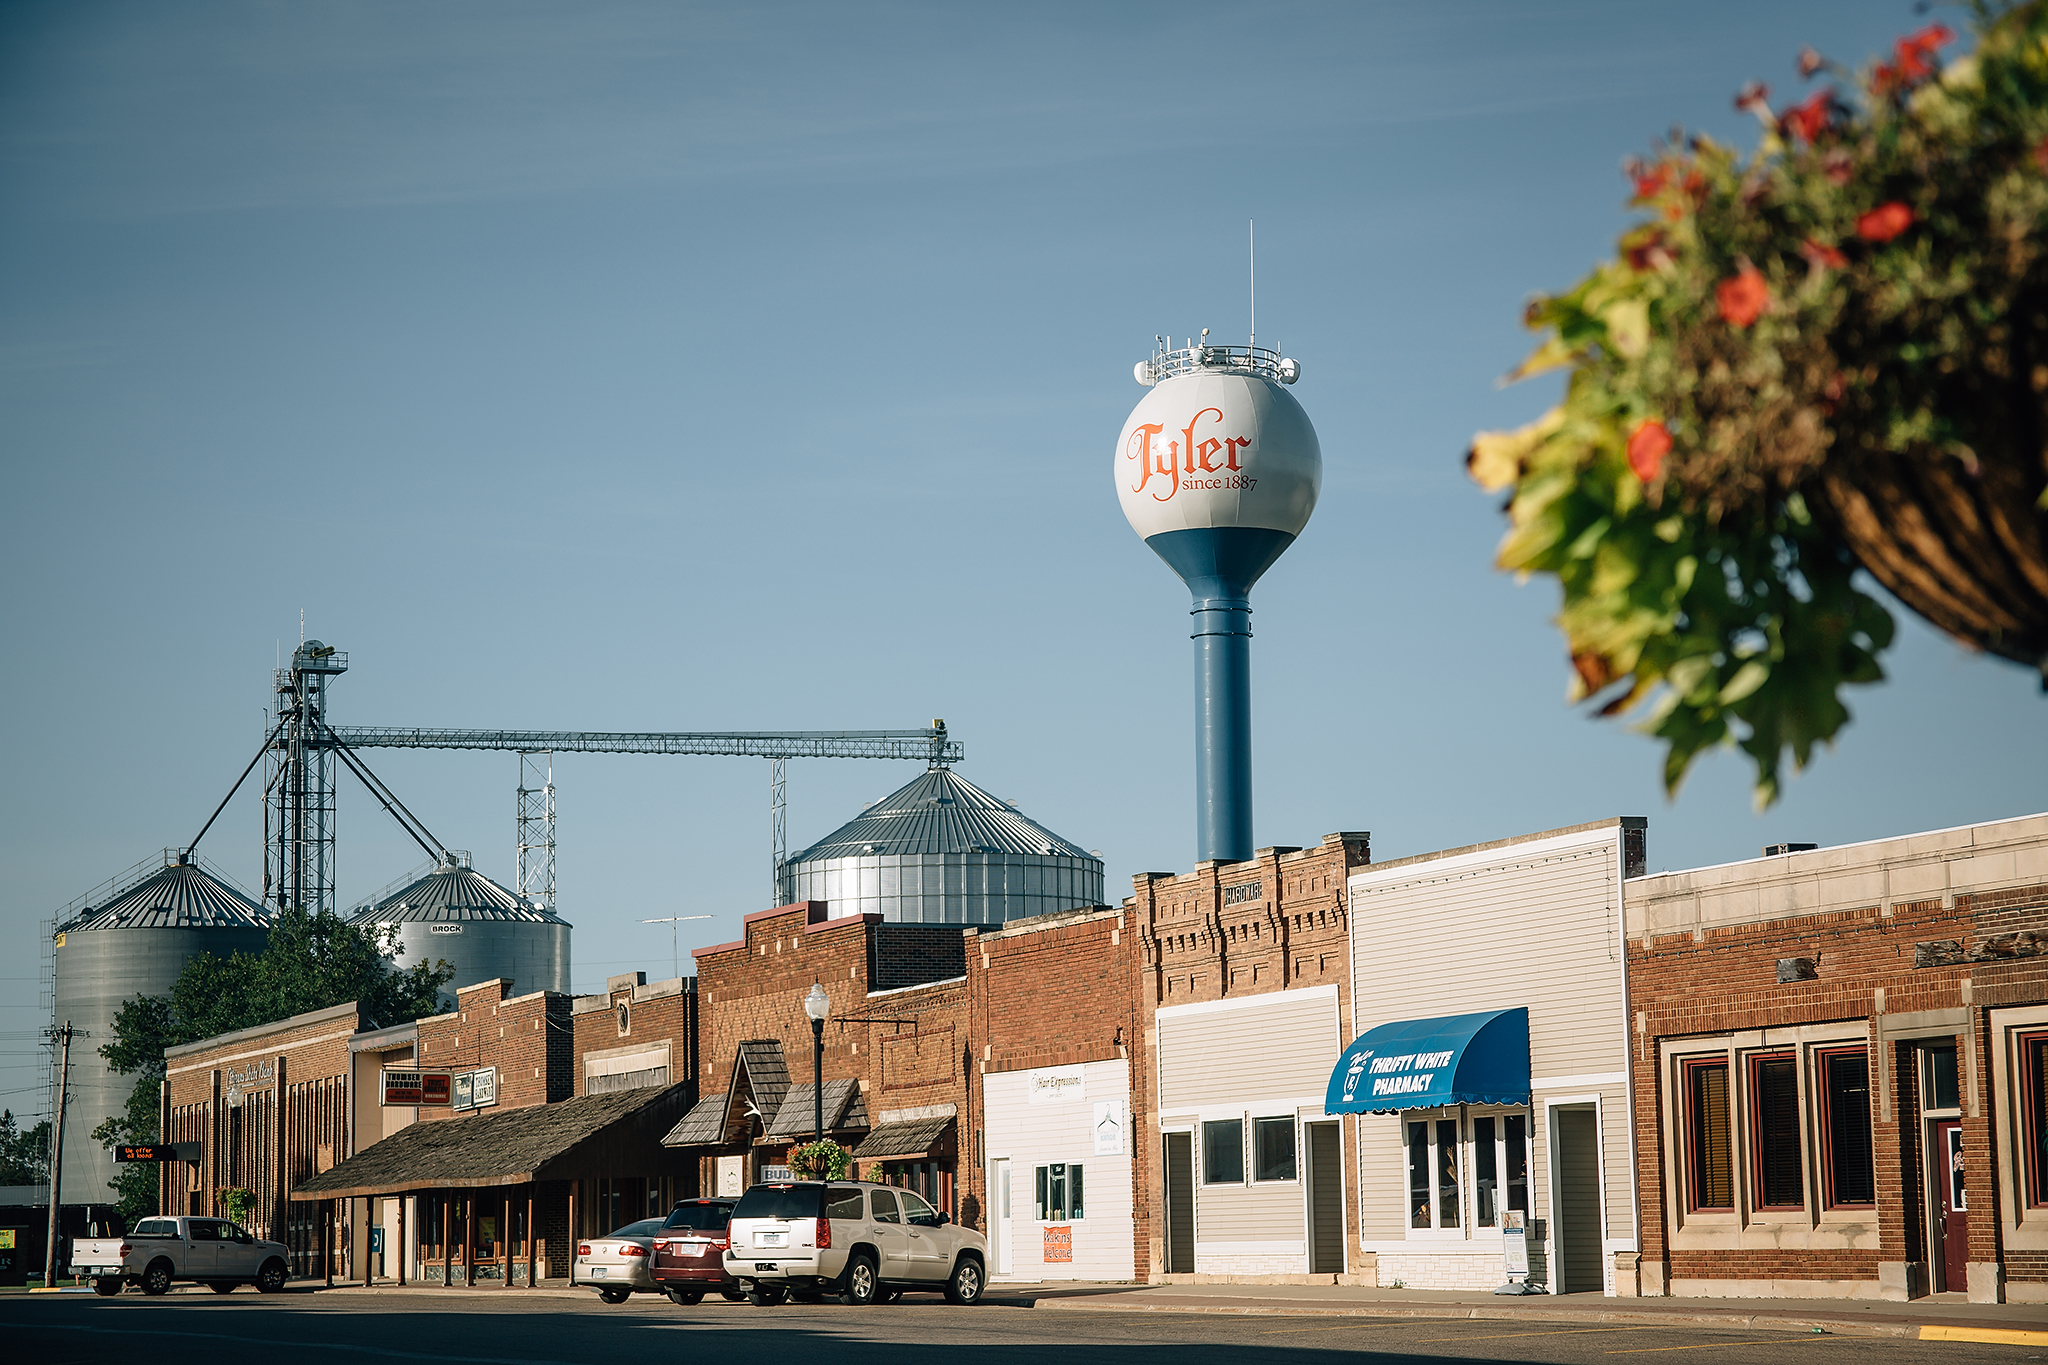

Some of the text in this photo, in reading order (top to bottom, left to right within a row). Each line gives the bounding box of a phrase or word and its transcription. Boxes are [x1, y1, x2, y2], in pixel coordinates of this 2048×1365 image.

[1126, 407, 1252, 502] Tyler
[1182, 474, 1258, 491] since 1887
[1368, 1050, 1455, 1075] THRIFTY WHITE
[1038, 1075, 1082, 1091] Hair Expressions
[1372, 1073, 1434, 1096] PHARMACY
[765, 1170, 795, 1180] BUD
